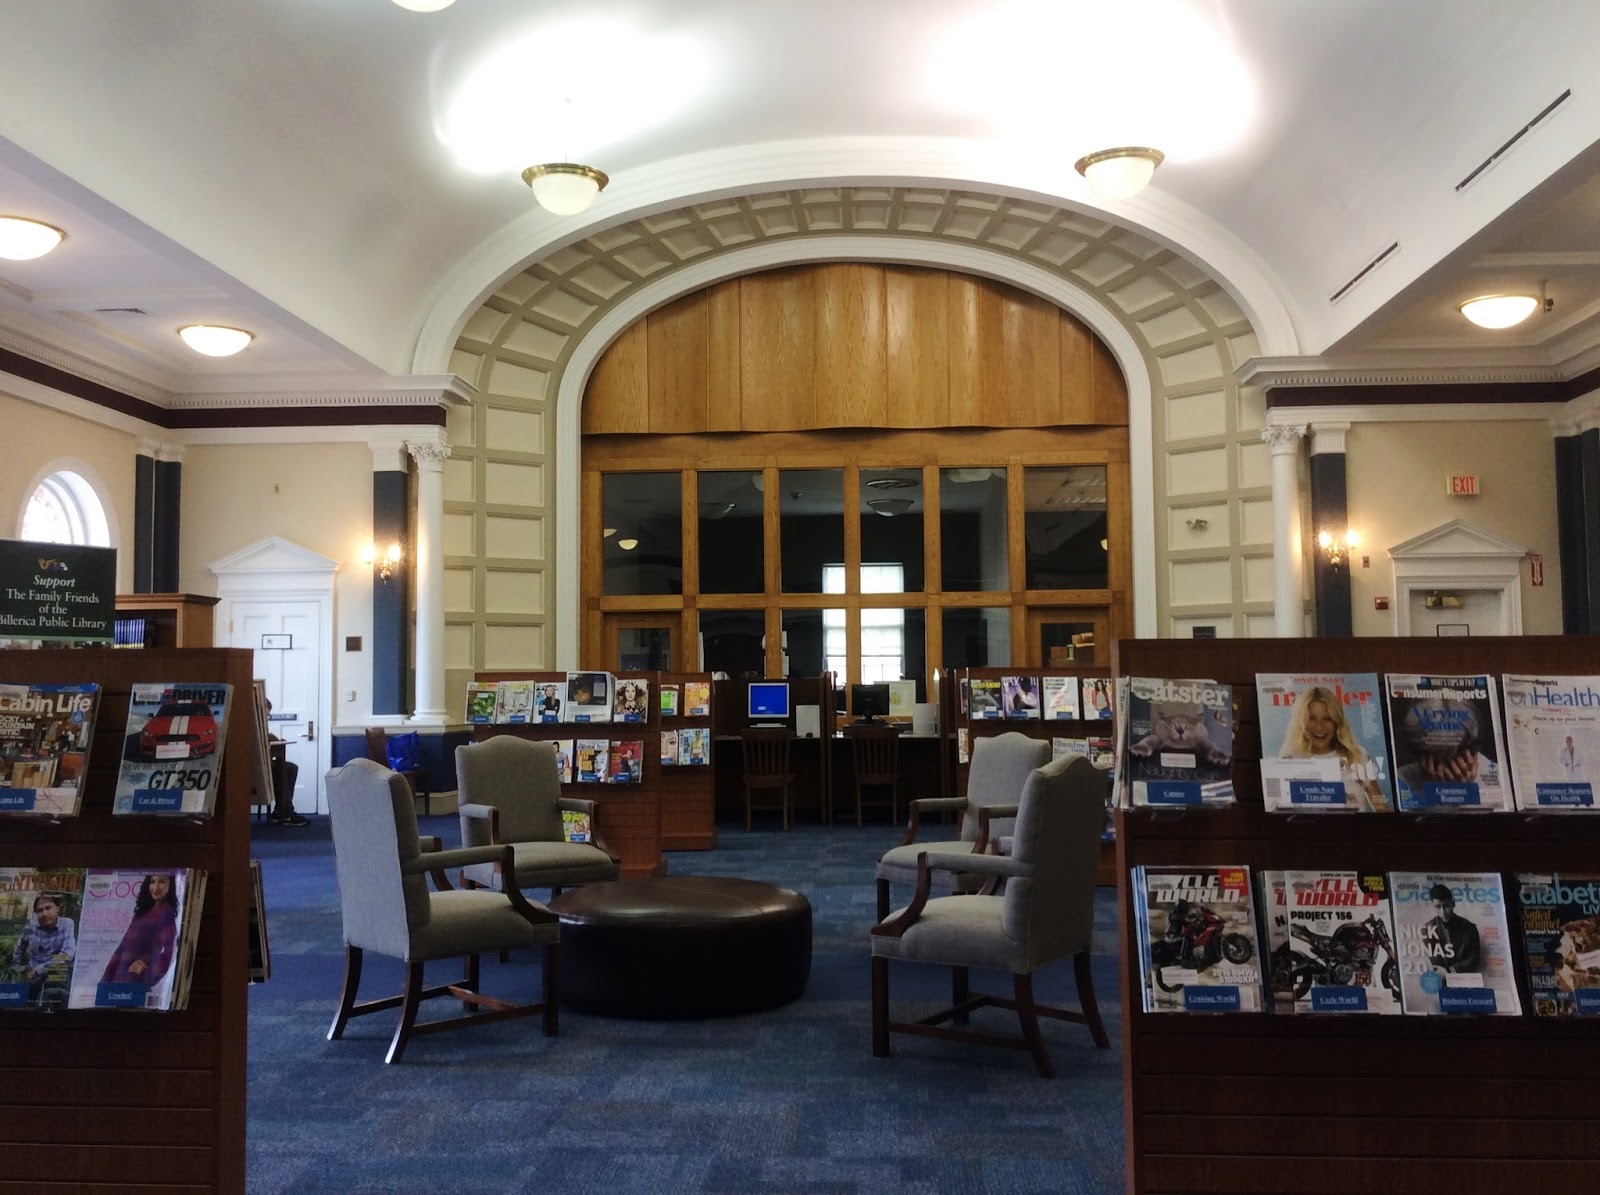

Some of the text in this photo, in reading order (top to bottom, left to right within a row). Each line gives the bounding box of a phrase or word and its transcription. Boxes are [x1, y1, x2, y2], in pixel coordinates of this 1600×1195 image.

[1452, 476, 1475, 493] EXIT
[33, 575, 76, 589] Support
[6, 588, 100, 604] The Family Friends
[38, 602, 68, 615] of the
[39, 616, 70, 628] Public
[72, 618, 107, 631] Library
[56, 693, 91, 712] Life
[172, 690, 225, 705] DRIVER
[148, 769, 211, 791] GT350
[1173, 874, 1220, 889] YCLE
[1314, 879, 1358, 893] YCLE
[1519, 872, 1600, 905] diabet
[1156, 888, 1240, 904] WORLD
[1295, 892, 1379, 906] WORLD
[1395, 883, 1501, 903] Diaetes
[1291, 911, 1352, 921] PROJECT 156
[1401, 925, 1439, 939] NICK
[1402, 943, 1456, 958] JONAS
